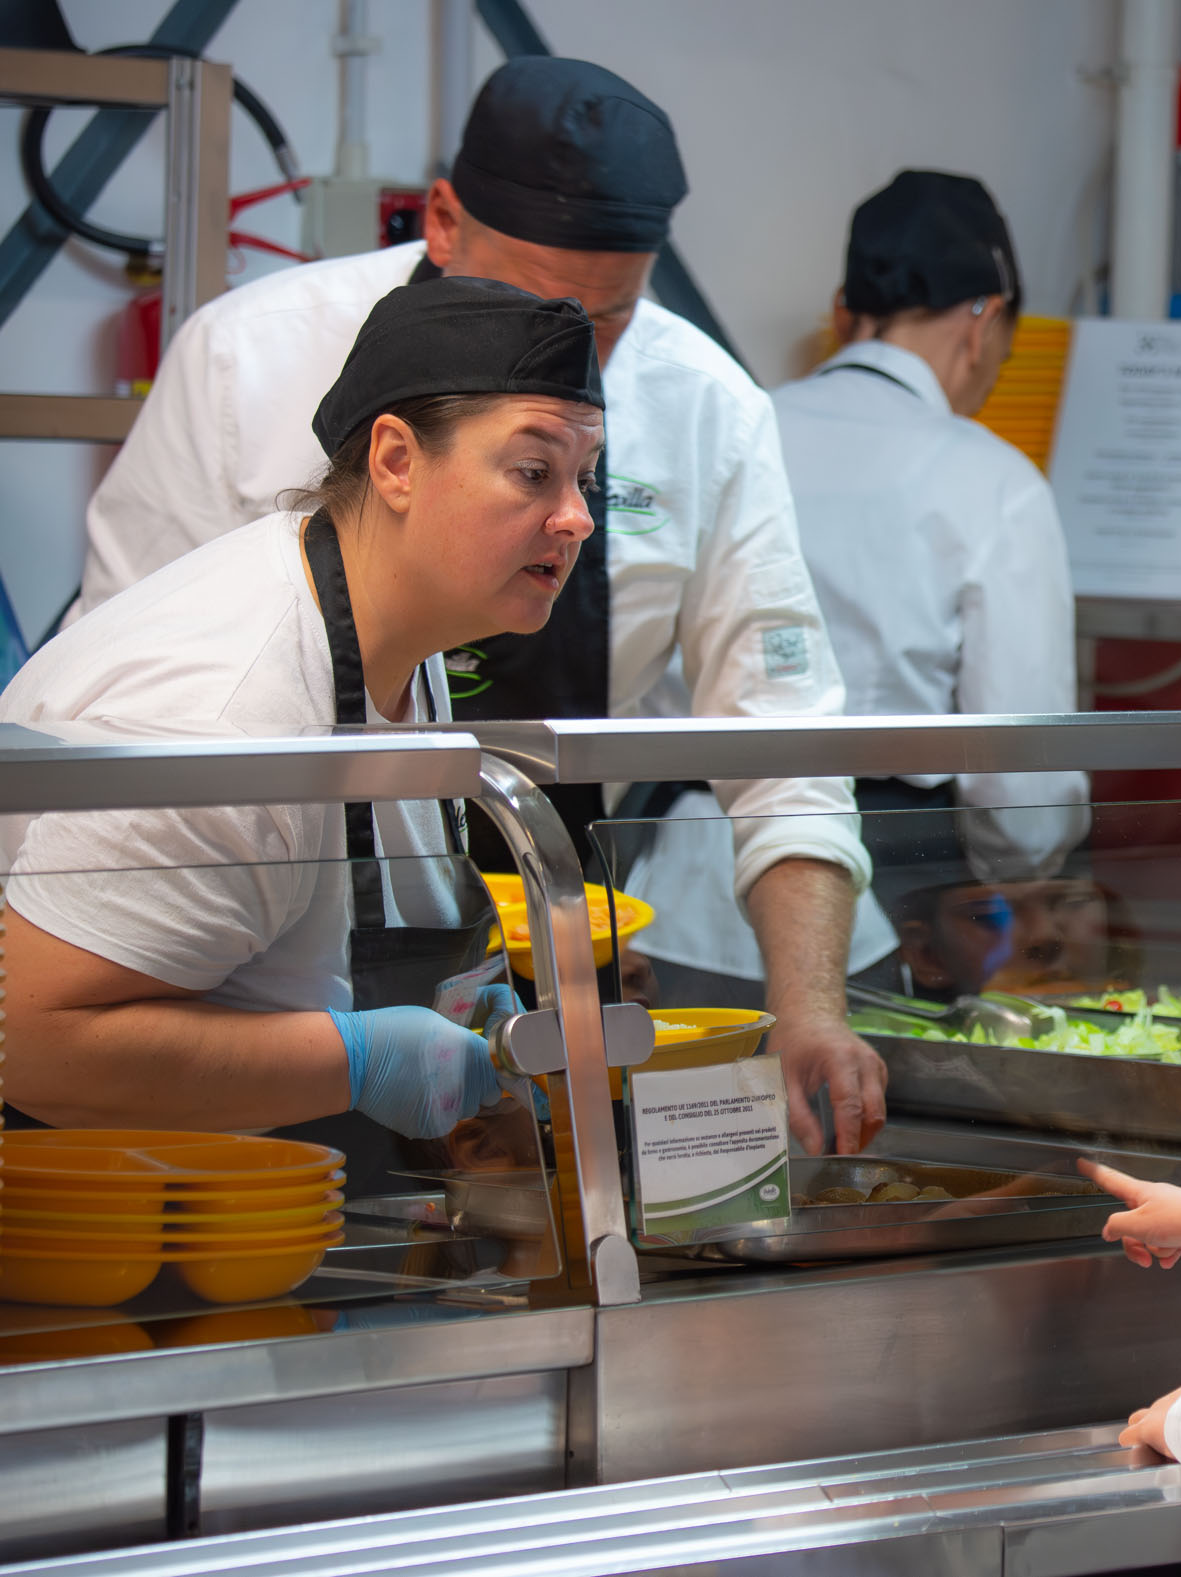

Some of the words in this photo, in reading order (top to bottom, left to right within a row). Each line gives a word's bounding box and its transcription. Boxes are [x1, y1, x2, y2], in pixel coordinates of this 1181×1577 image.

[642, 1105, 678, 1114] REGOLAMENTO
[719, 1097, 751, 1106] PARLAMENTO
[668, 1113, 677, 1121] DEL
[678, 1111, 704, 1120] CONSIGLIO
[720, 1106, 742, 1115] OTTOBRE
